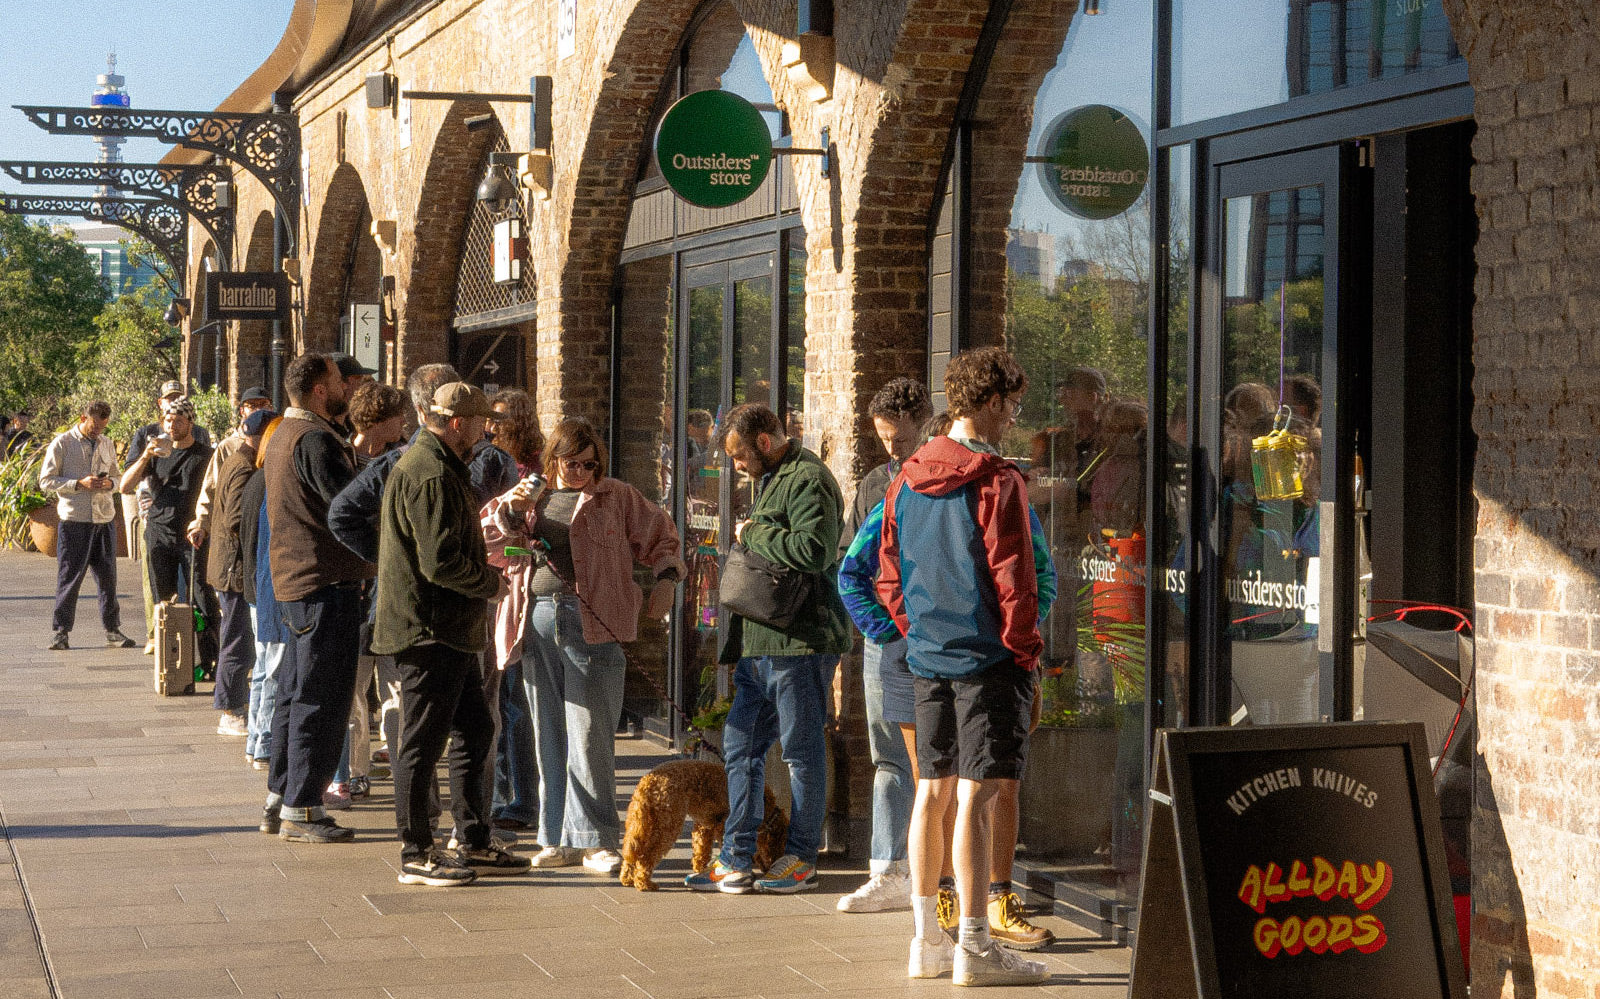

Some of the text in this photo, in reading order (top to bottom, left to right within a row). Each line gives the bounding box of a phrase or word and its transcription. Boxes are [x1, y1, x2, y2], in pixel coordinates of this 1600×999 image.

[710, 171, 752, 185] store
[219, 281, 277, 307] barrafina
[1285, 580, 1307, 611] sto
[1226, 767, 1378, 816] KITCHEN KNIVES
[1253, 913, 1388, 960] GOODS
